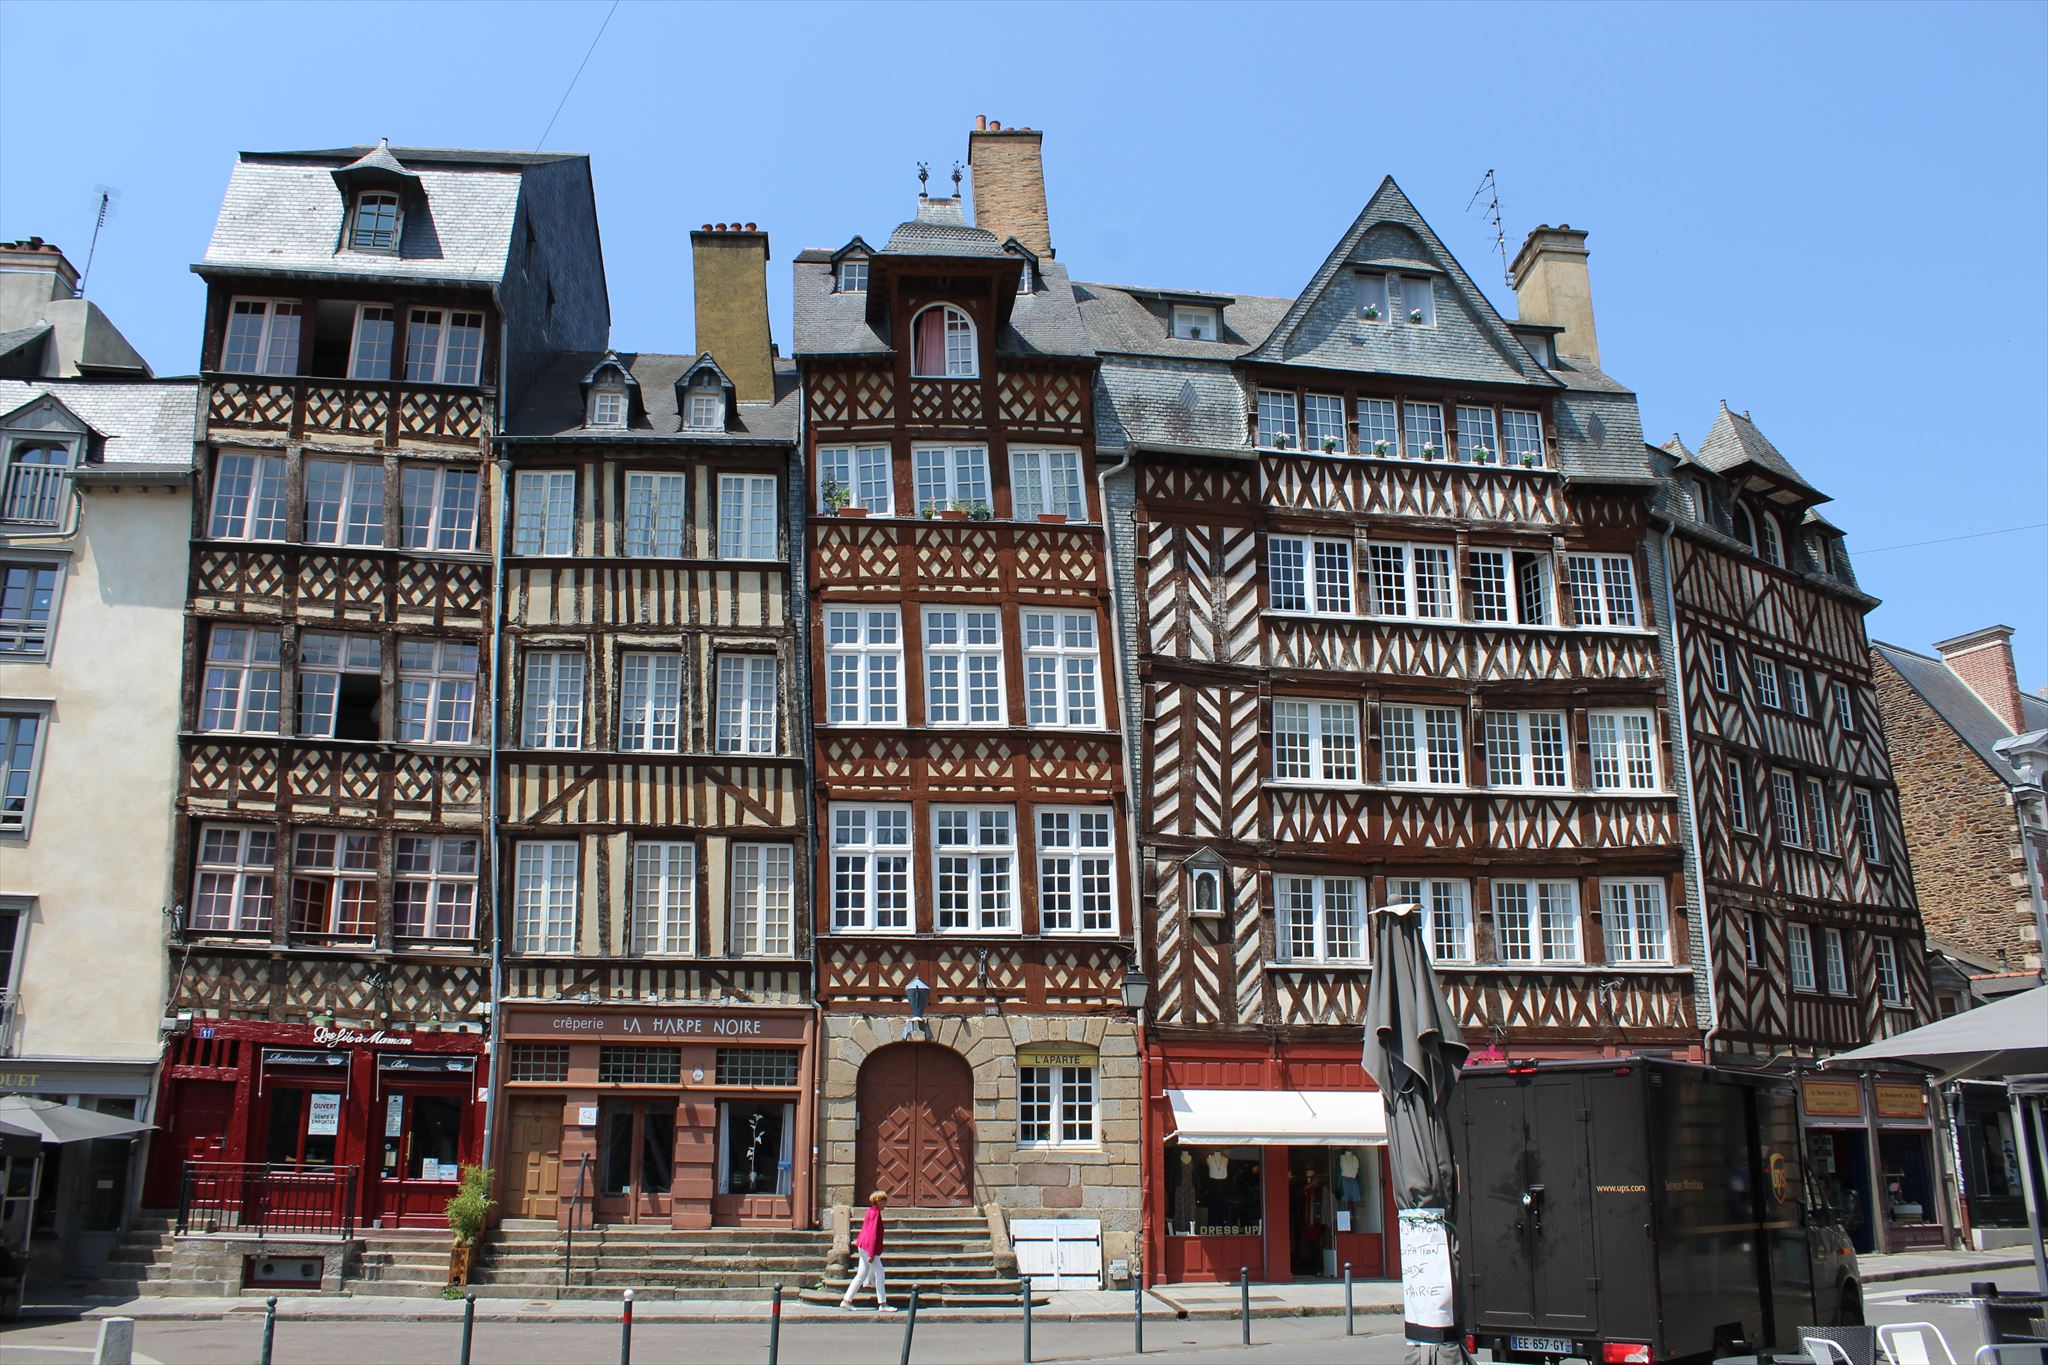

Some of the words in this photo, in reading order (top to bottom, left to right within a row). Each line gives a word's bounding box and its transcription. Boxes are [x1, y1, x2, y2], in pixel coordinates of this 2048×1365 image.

[553, 1017, 604, 1031] crêperie
[623, 1018, 642, 1033] LA
[653, 1018, 702, 1034] HARPE
[714, 1018, 760, 1035] NOIRE
[202, 1030, 212, 1038] 11
[313, 1027, 336, 1043] Les
[327, 1027, 355, 1048] fils
[355, 1033, 364, 1043] à
[364, 1030, 413, 1046] Maman
[267, 1053, 318, 1062] Restaurant
[391, 1059, 409, 1068] Bar
[1596, 1184, 1646, 1194] www.ups.com
[1200, 1226, 1239, 1235] DRESS
[1244, 1226, 1259, 1234] UP
[1517, 1338, 1565, 1351] EE-657-GY
